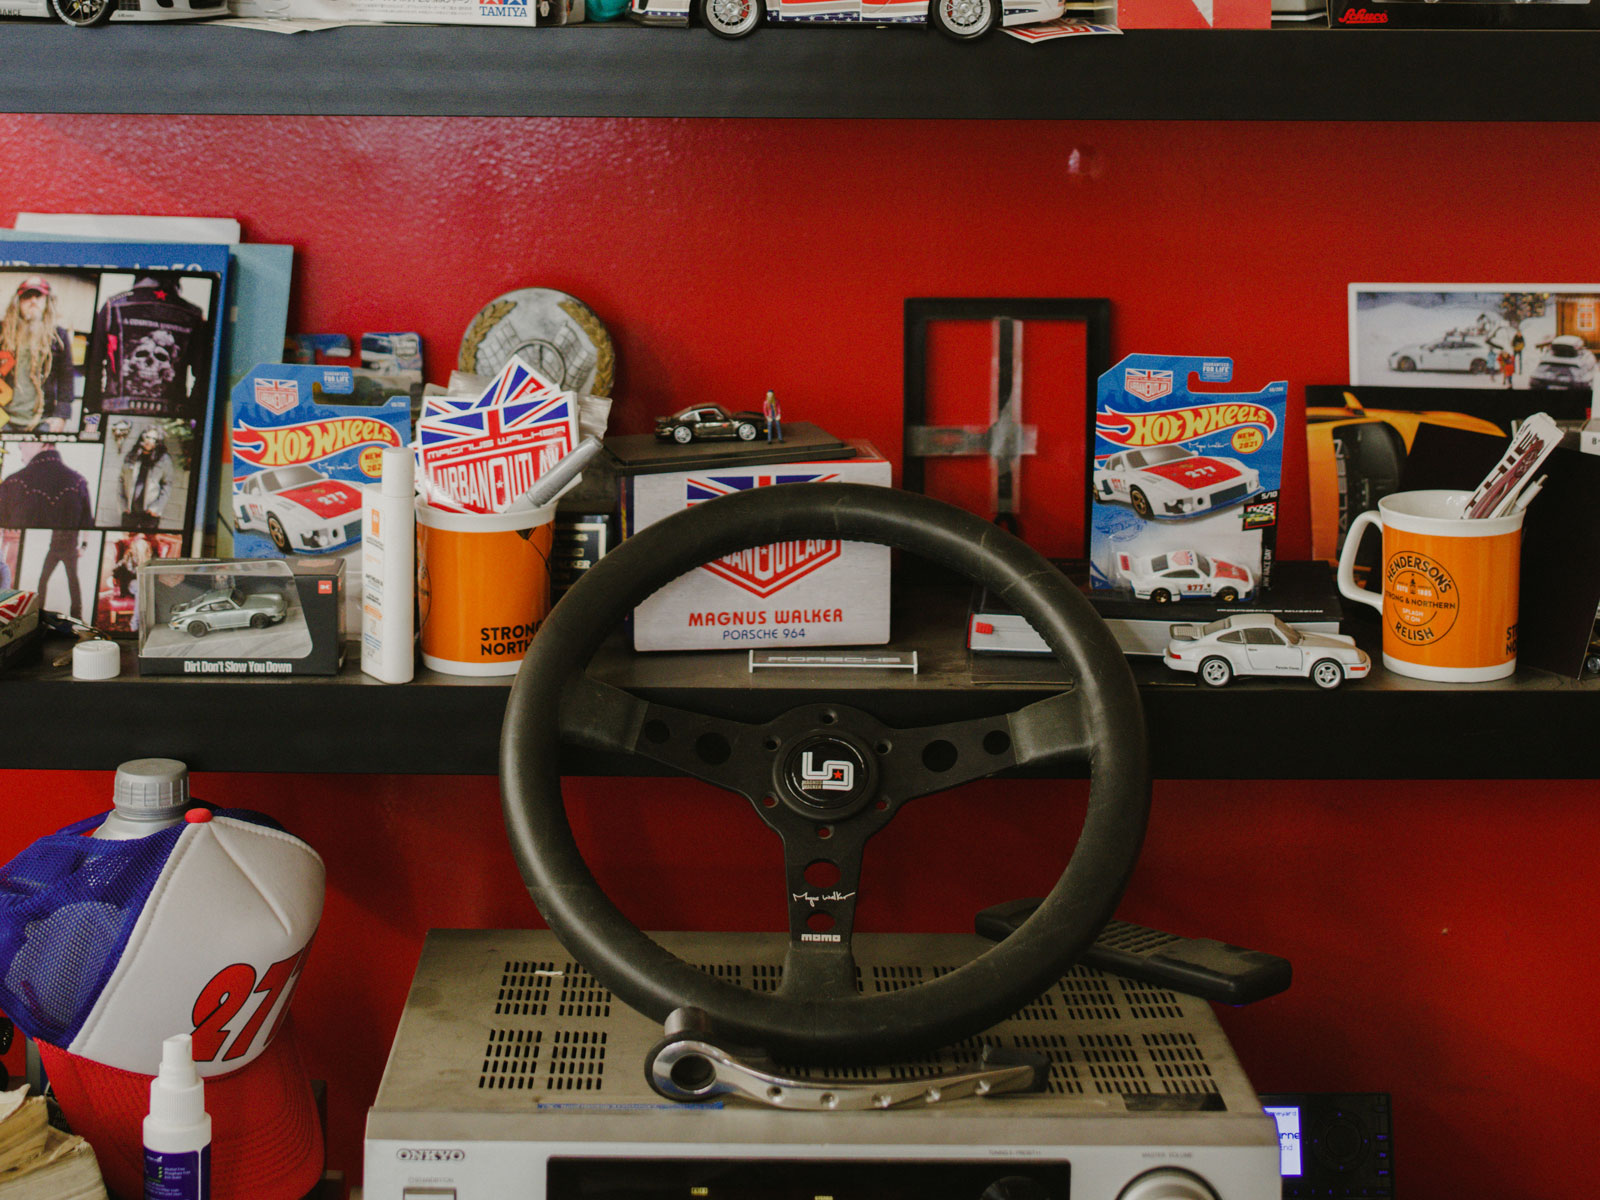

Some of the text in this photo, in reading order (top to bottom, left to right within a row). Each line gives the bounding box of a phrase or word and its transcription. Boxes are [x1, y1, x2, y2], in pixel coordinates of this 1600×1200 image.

[479, 5, 528, 18] TAMIYA
[1237, 431, 1256, 440] NEW
[427, 425, 567, 460] MAGNUS WALKER
[365, 451, 383, 461] NEW
[366, 463, 383, 472] 202
[1185, 466, 1217, 479] 277
[317, 490, 348, 505] 277
[1386, 555, 1452, 593] HENDERSON'S
[1411, 599, 1456, 610] NORTHERN
[688, 608, 843, 626] MAGNUS WALKER
[723, 628, 807, 640] PORSCHE 964
[1395, 621, 1435, 641] RELISH
[184, 660, 293, 673] Dirt Don't Slow You Down
[801, 933, 841, 943] momo
[396, 1148, 466, 1162] ONKYO
